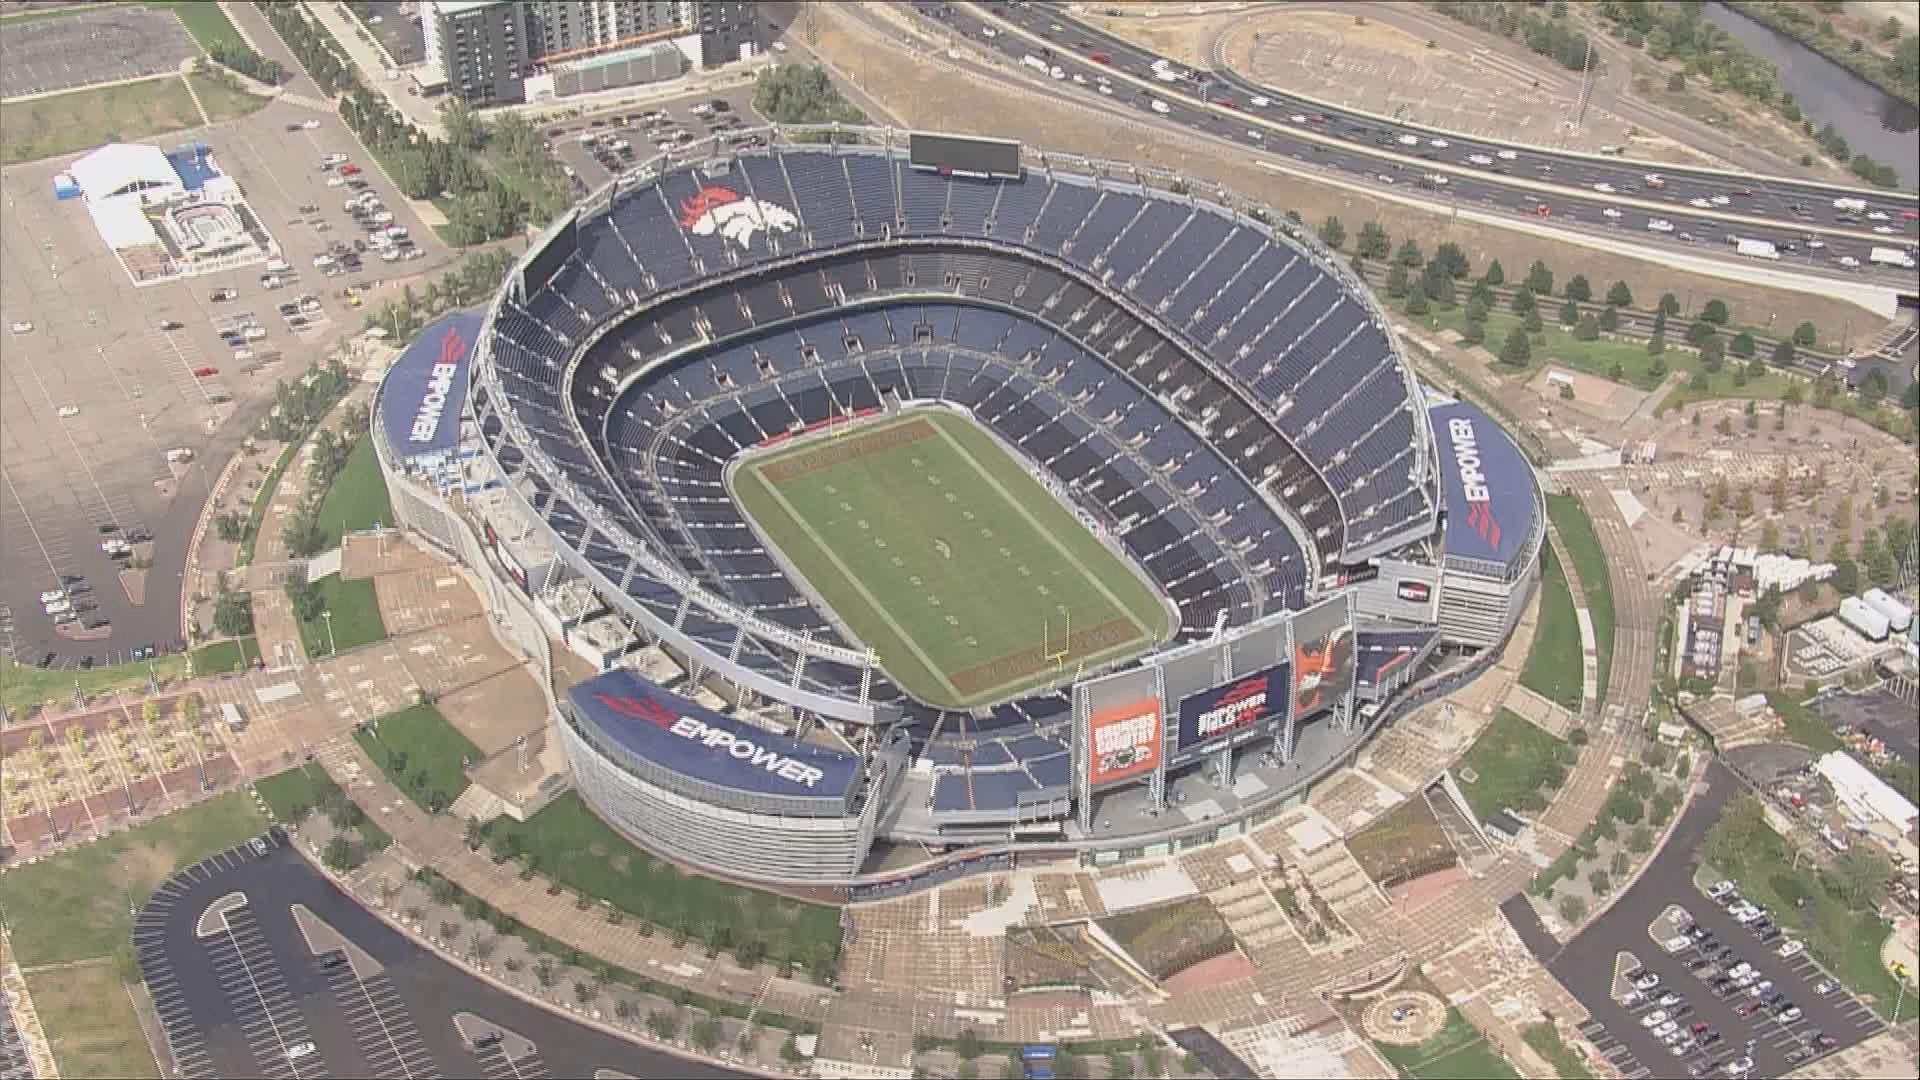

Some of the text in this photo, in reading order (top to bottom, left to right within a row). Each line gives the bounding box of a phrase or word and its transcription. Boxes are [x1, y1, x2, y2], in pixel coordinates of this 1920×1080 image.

[409, 363, 456, 441] EMPOWER
[1449, 418, 1490, 501] EMPOWER
[670, 715, 823, 788] EMPOWER
